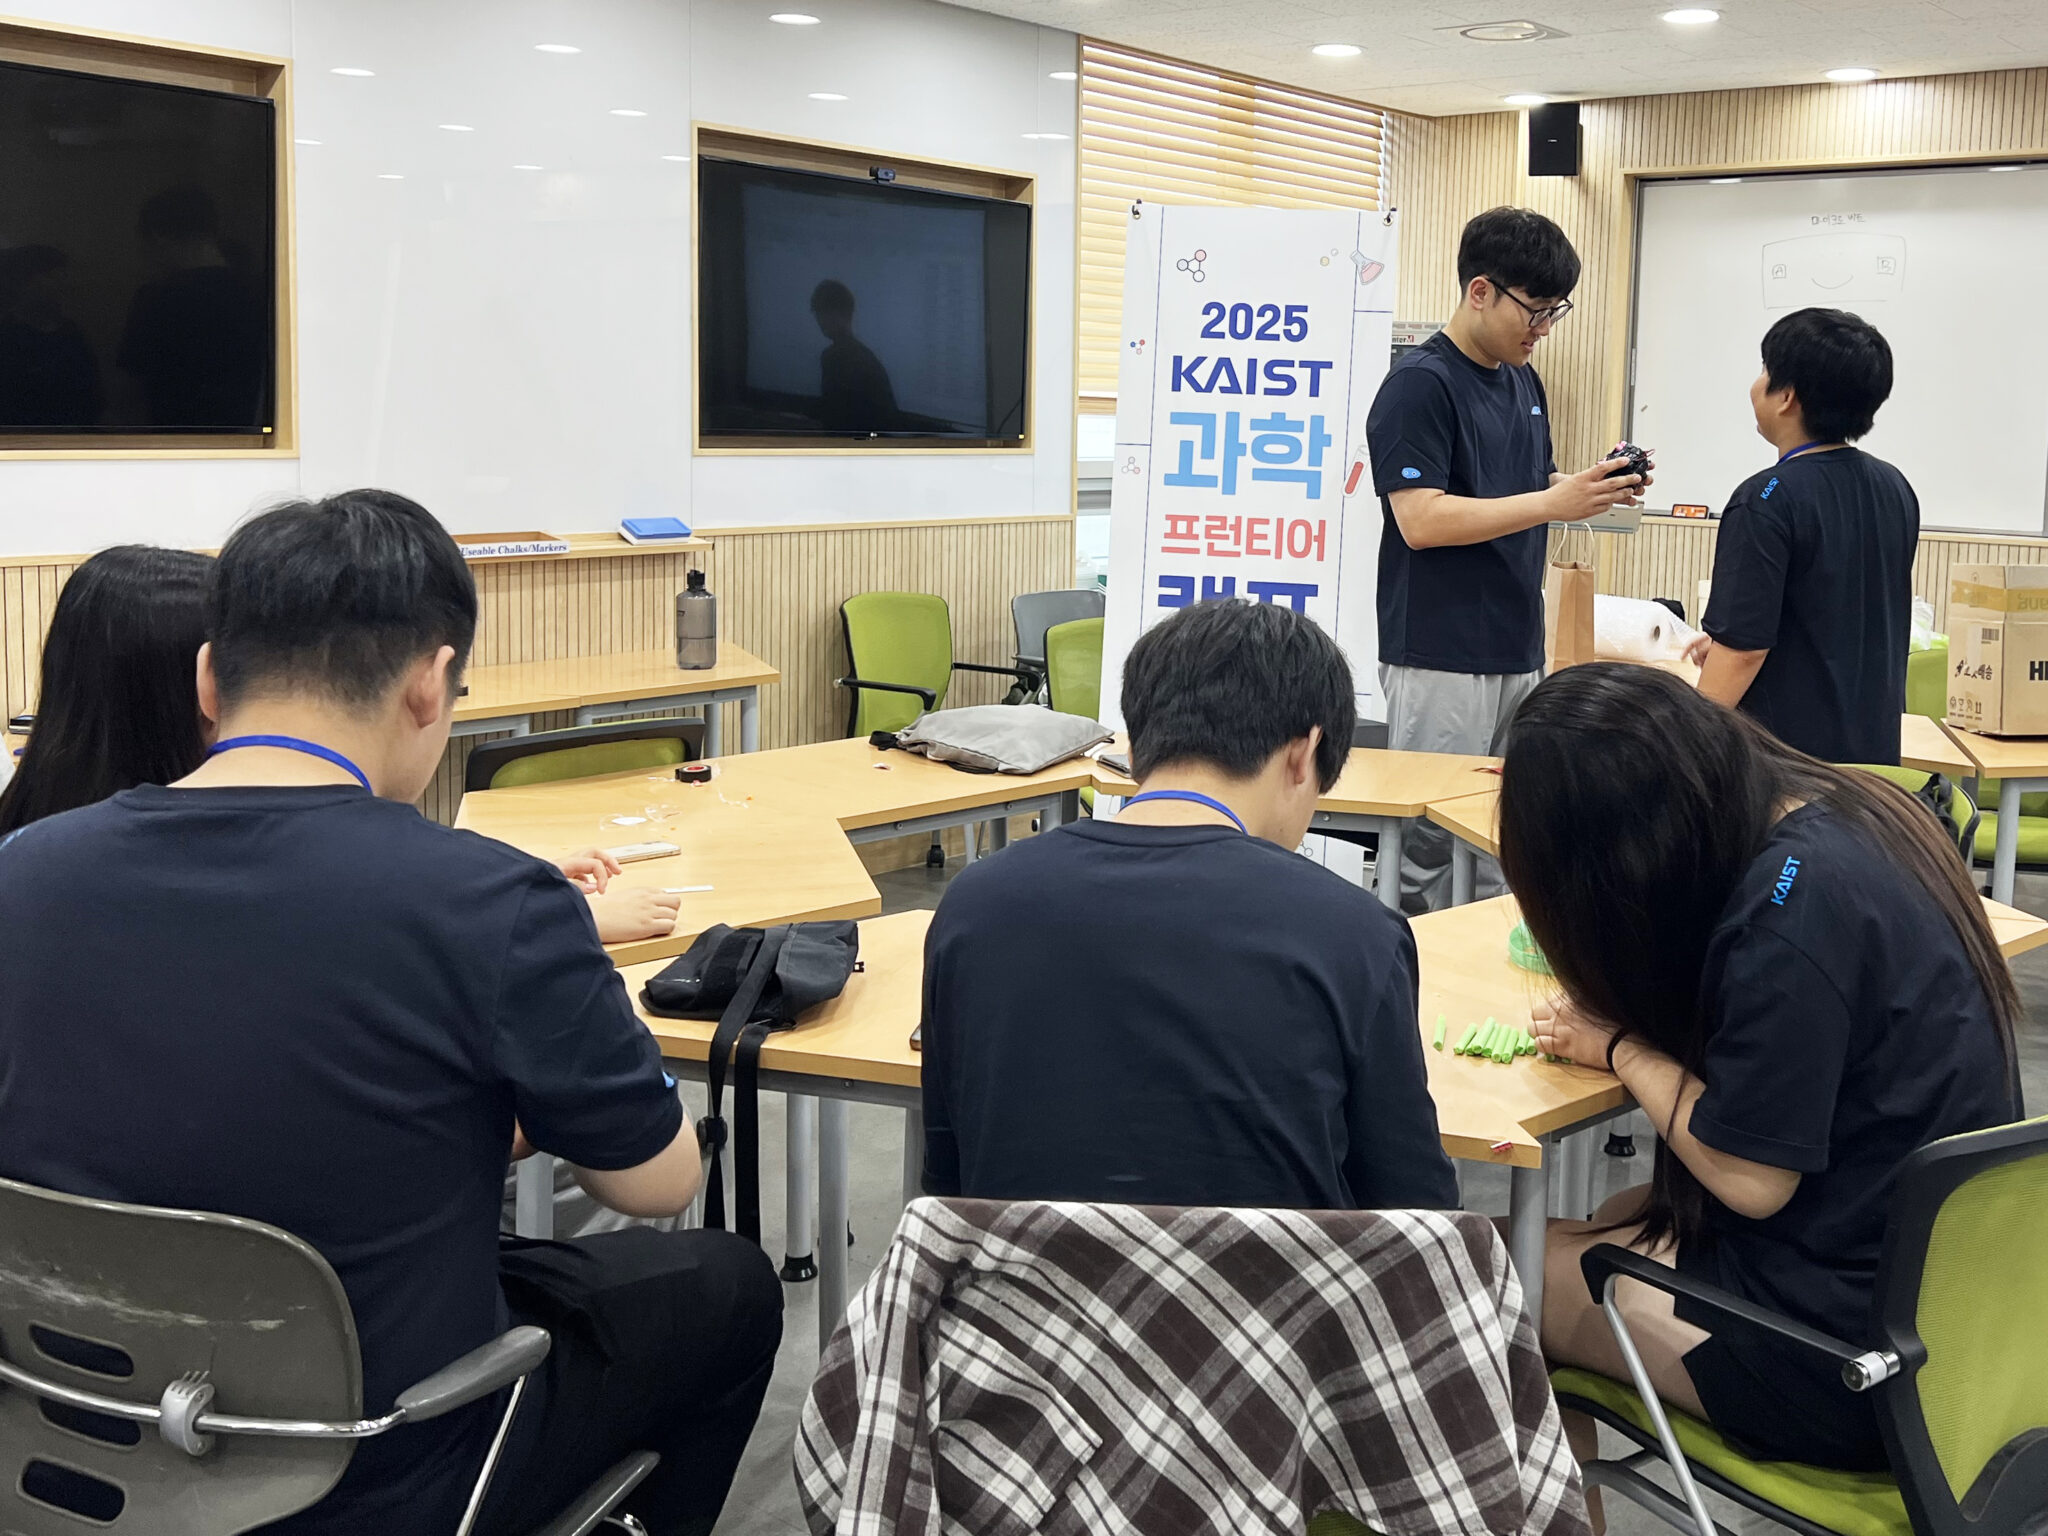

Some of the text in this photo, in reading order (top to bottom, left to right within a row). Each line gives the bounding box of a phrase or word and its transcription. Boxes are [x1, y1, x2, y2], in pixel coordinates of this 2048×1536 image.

[1200, 301, 1308, 342] 2025
[1171, 355, 1333, 397] KAIST
[1164, 411, 1332, 499] 과학
[1760, 477, 1779, 500] KAIS
[461, 543, 567, 556] Useable Chalks/Markers
[1161, 514, 1326, 562] 프런티어
[2029, 661, 2048, 681] H
[1771, 855, 1801, 906] KAIST
